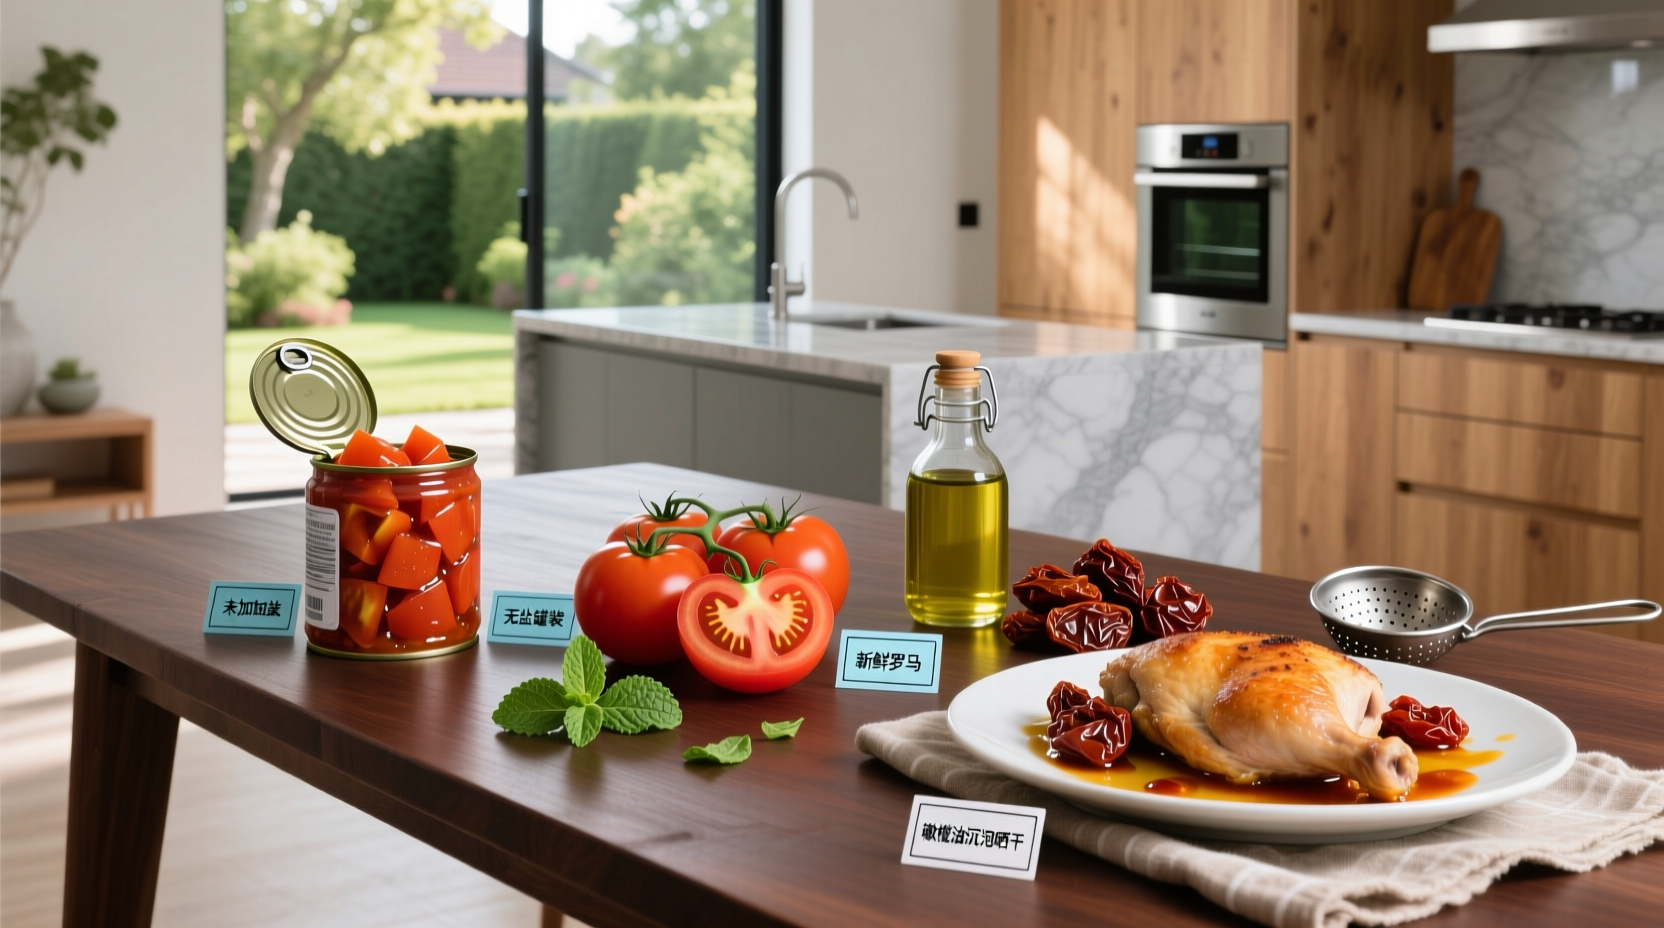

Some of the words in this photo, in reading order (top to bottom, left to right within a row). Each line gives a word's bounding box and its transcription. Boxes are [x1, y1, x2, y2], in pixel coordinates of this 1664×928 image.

[503, 607, 565, 627] 无盐罐装
[855, 650, 921, 672] 新鲜罗马
